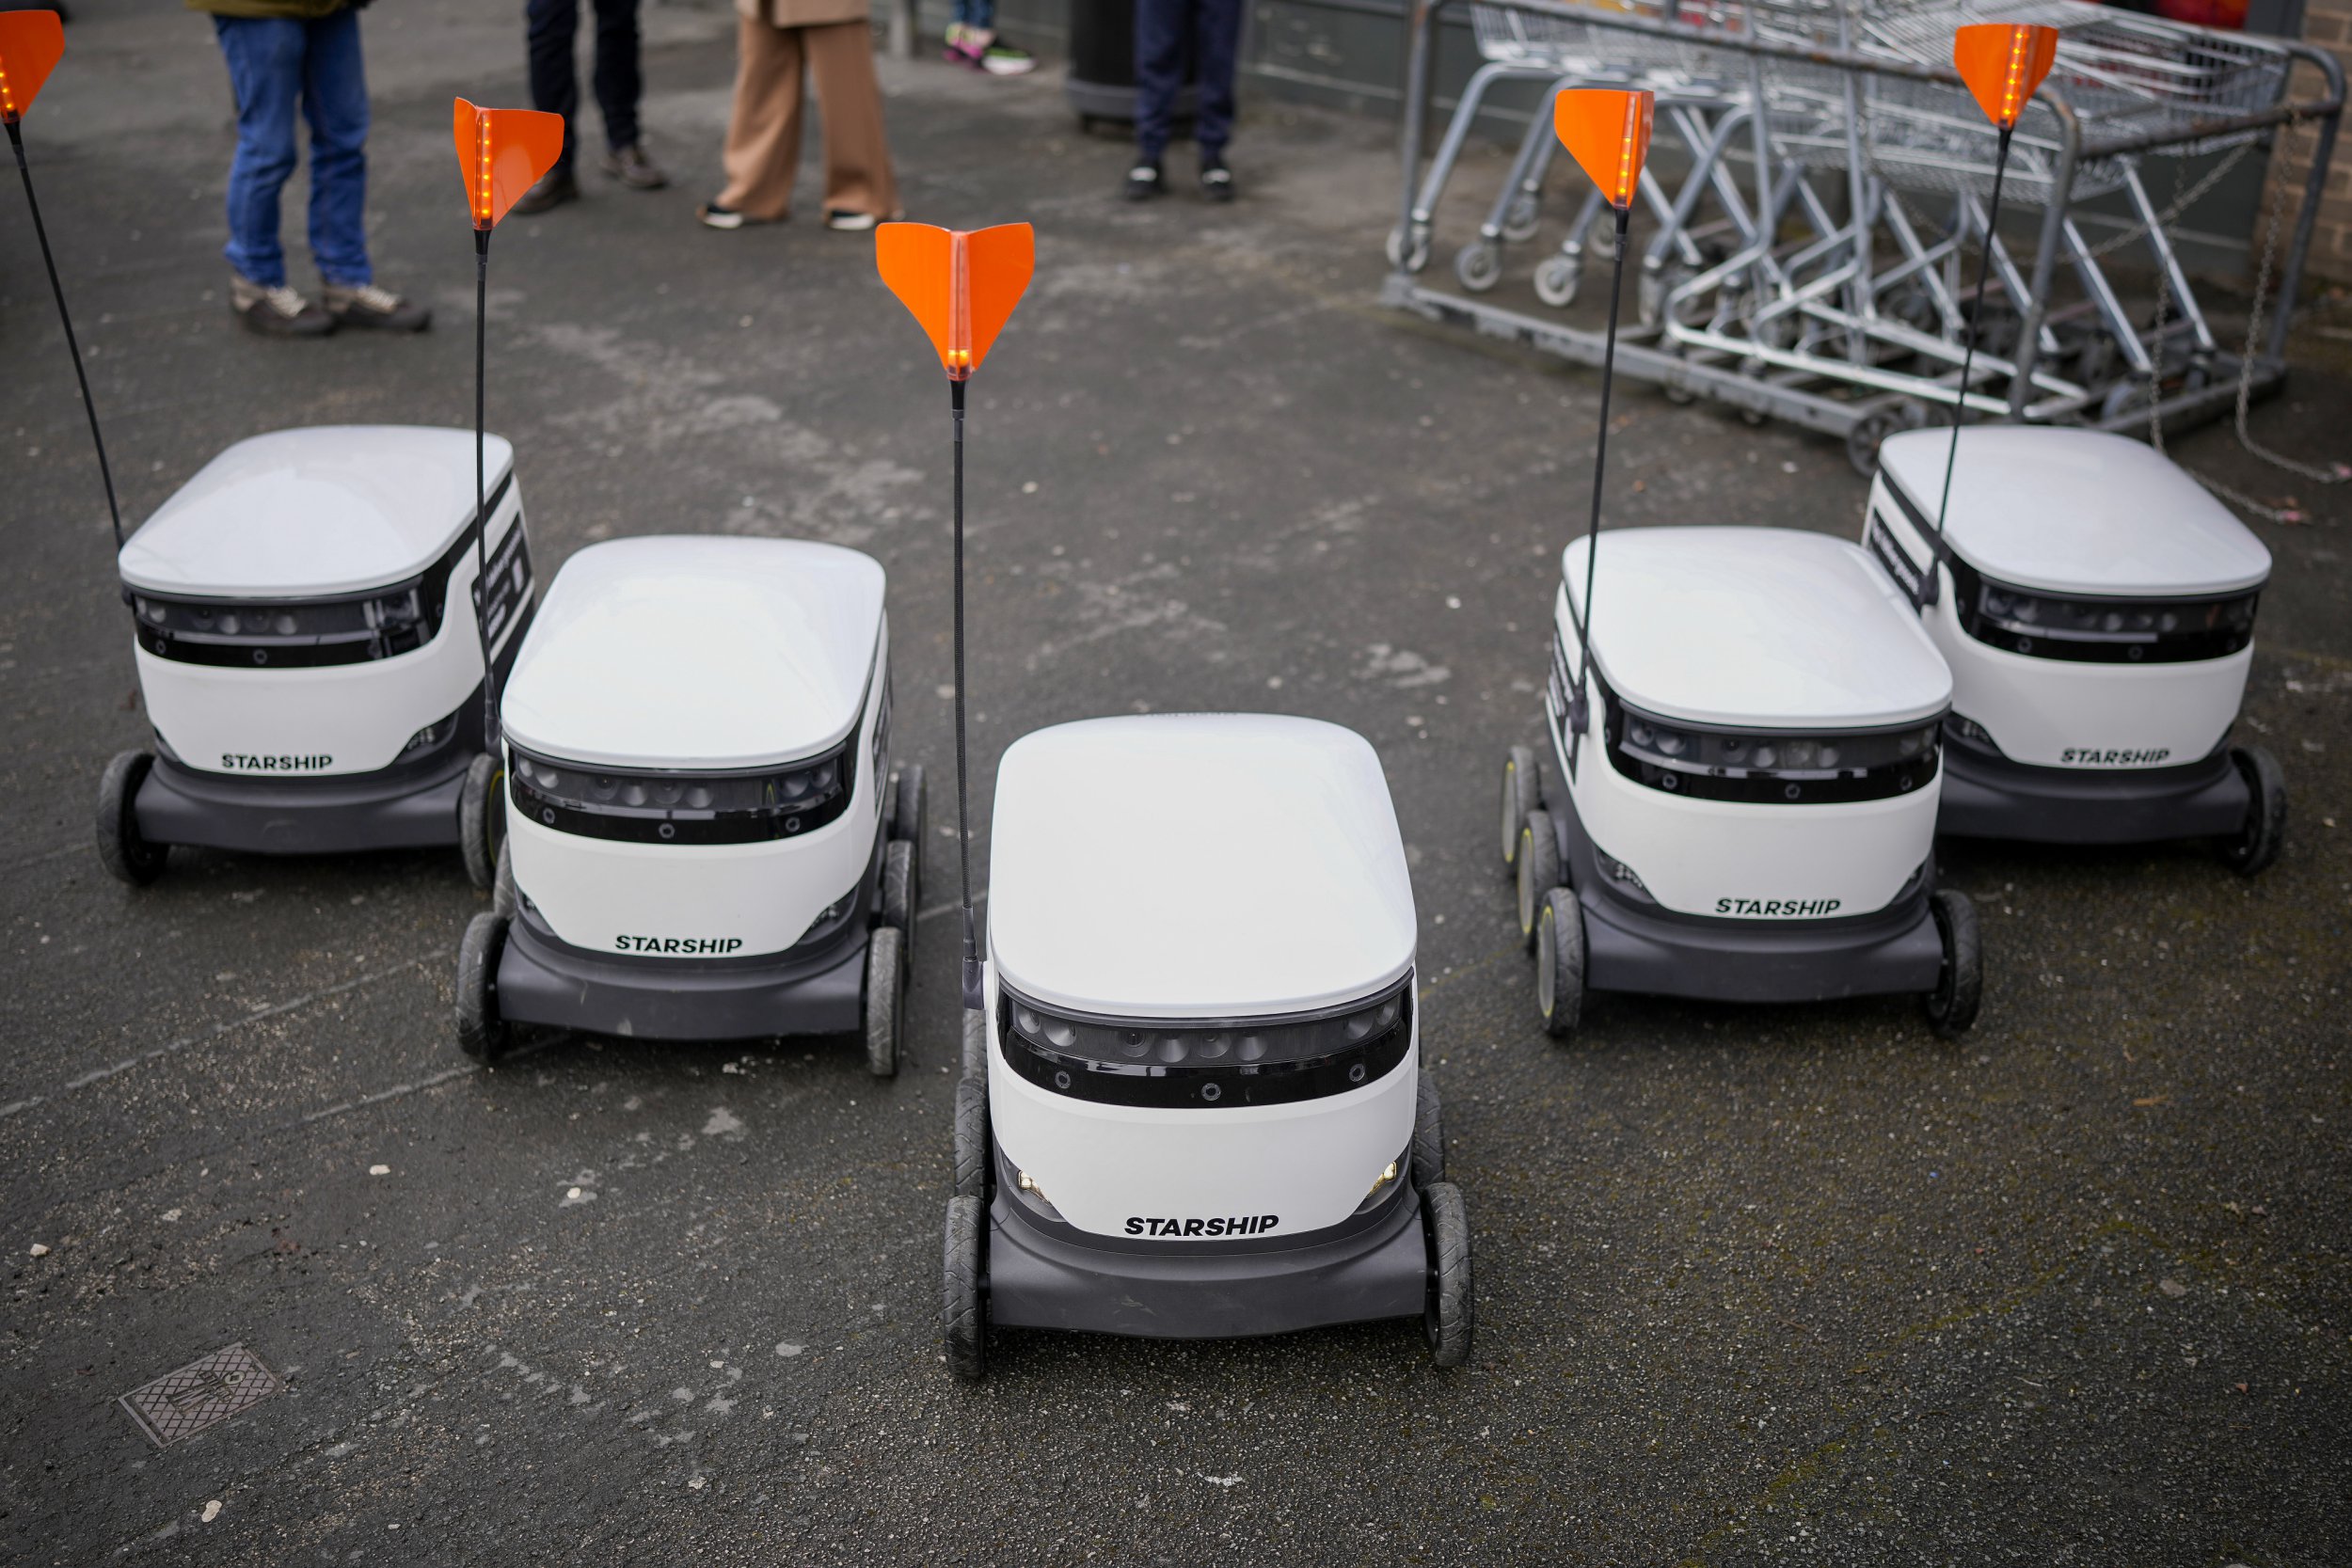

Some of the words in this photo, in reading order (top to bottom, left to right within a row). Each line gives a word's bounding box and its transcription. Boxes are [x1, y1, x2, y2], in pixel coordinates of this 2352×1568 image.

[221, 753, 334, 771] STARSHIP
[2060, 748, 2171, 764] STARSHIP
[1715, 897, 1841, 916] STARSHIP
[614, 933, 743, 954] STARSHIP
[1123, 1213, 1280, 1238] STARSHIP
